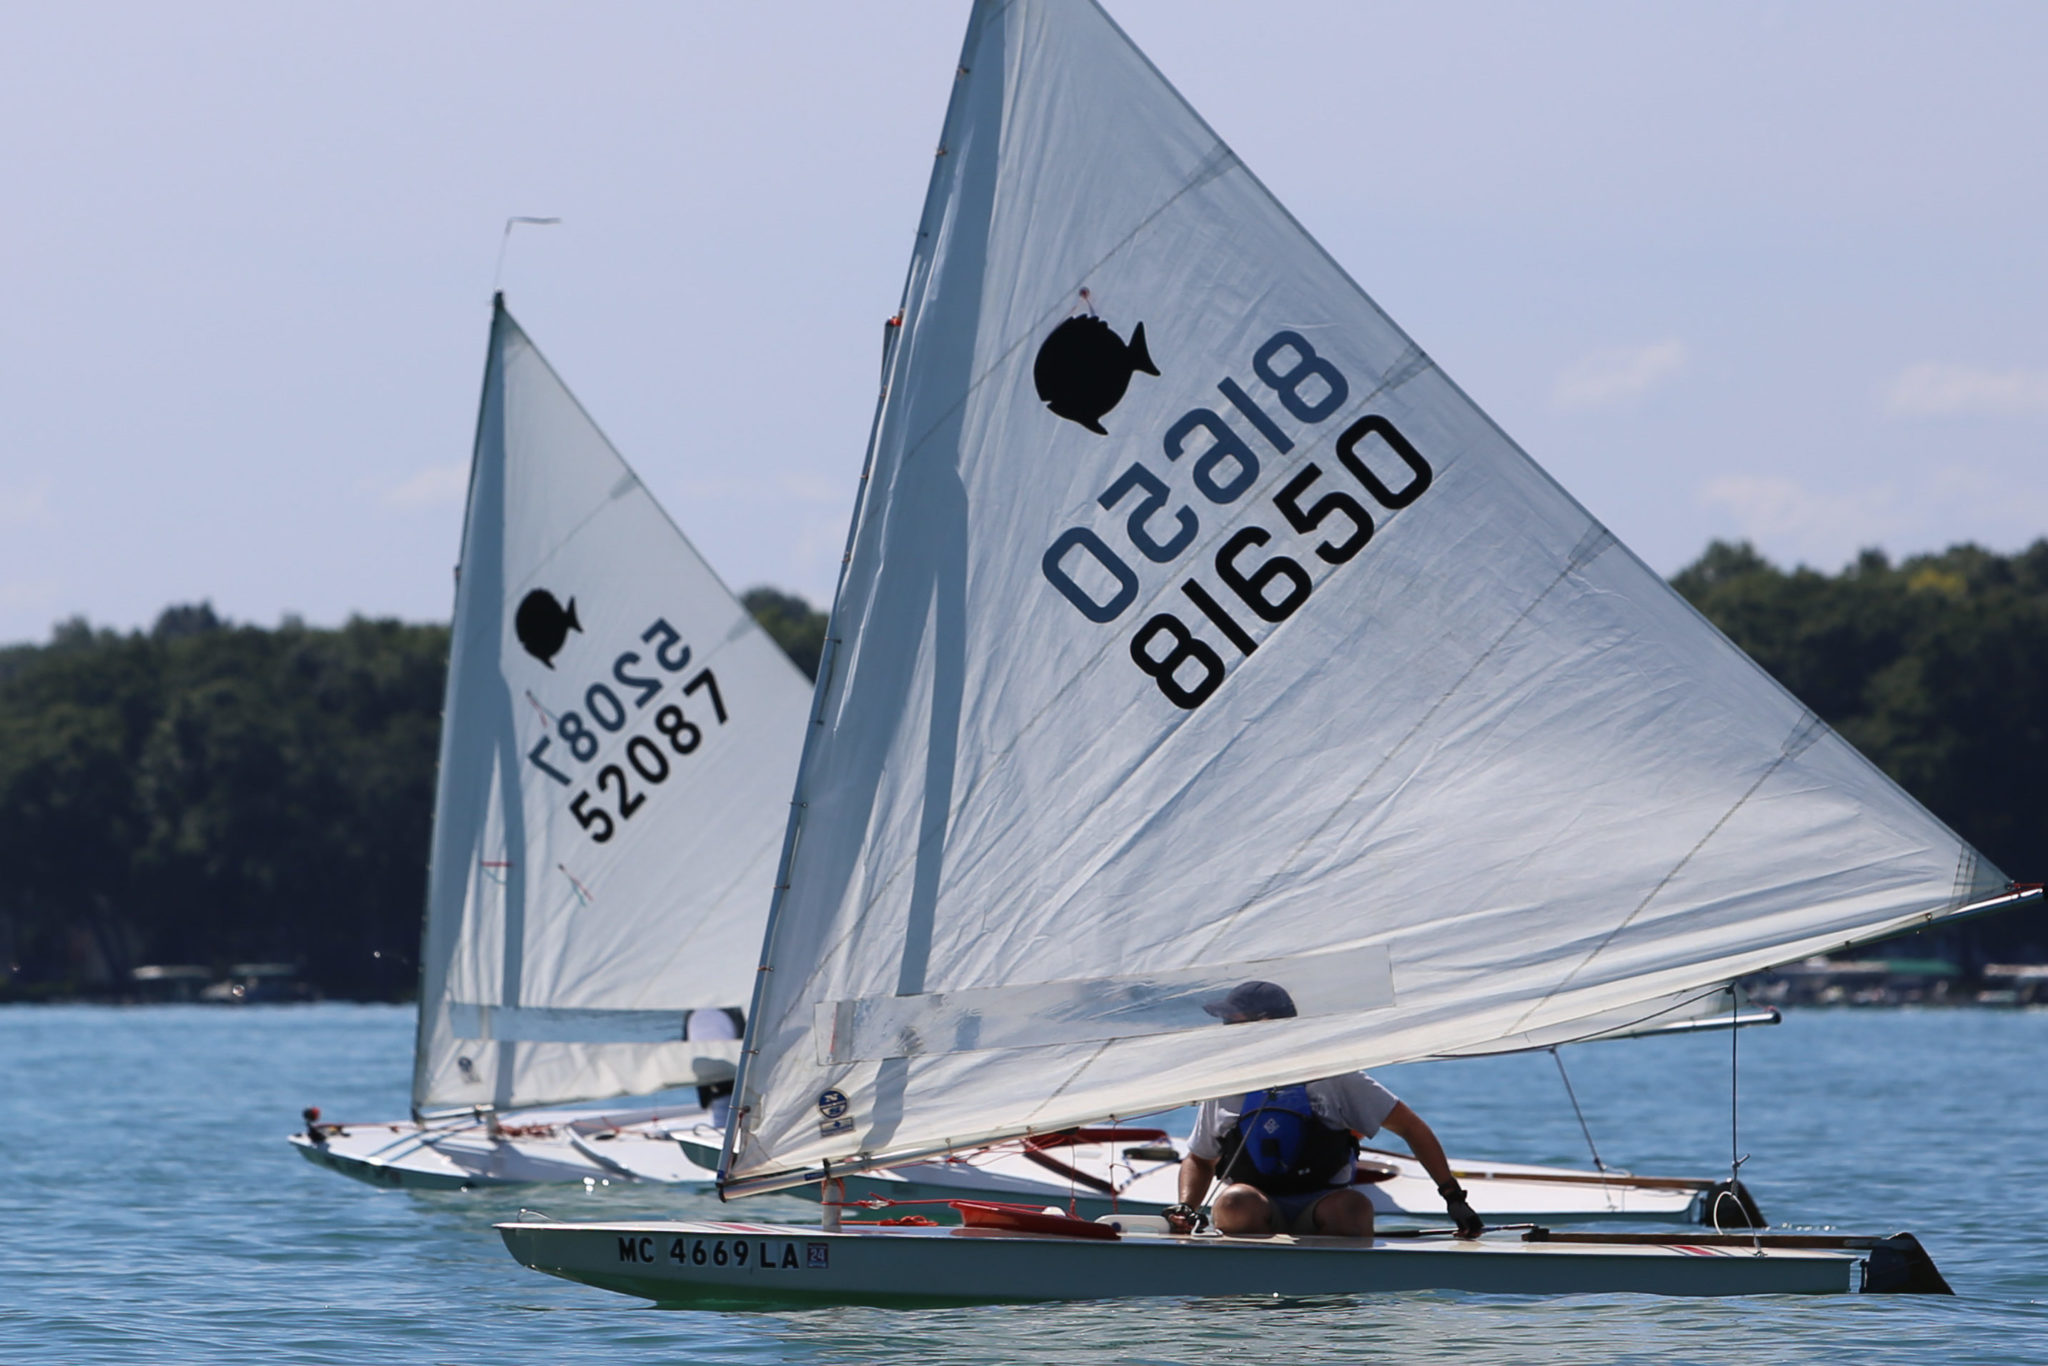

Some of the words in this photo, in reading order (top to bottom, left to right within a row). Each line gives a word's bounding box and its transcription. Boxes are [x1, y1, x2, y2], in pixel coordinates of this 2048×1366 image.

[1130, 414, 1433, 710] 81650
[569, 667, 728, 843] 52087
[618, 1237, 654, 1263] MC
[670, 1238, 749, 1266] 4669
[760, 1242, 799, 1269] LA
[810, 1248, 825, 1261] 24
